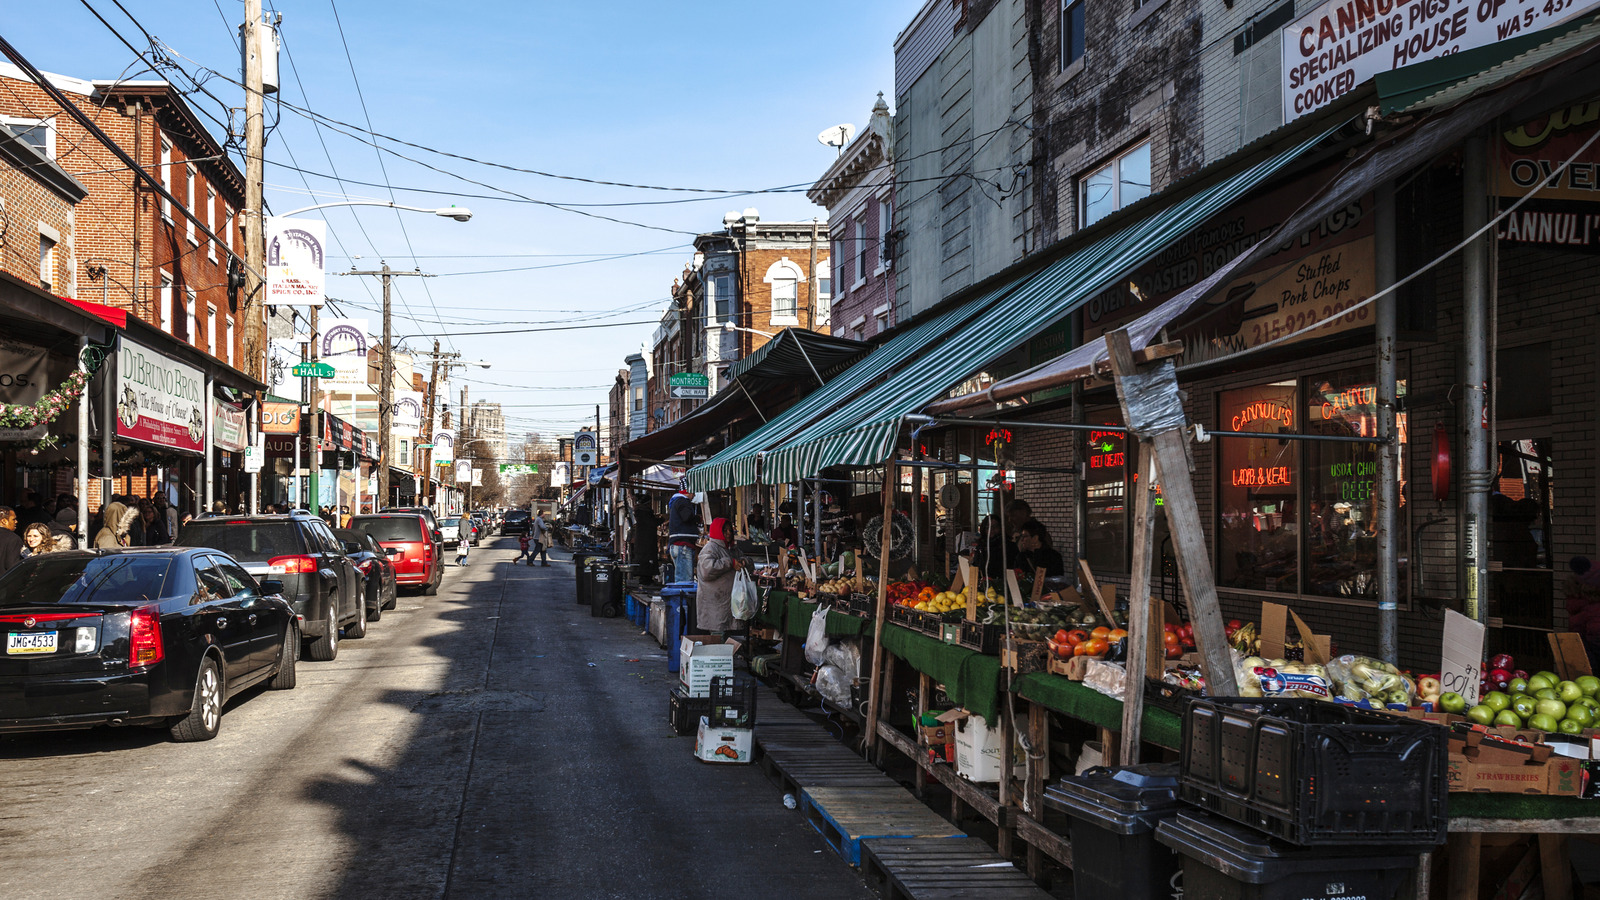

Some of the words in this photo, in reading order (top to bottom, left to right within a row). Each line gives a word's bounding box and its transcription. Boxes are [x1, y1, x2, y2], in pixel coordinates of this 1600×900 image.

[1289, 14, 1403, 89] SPECIALIZING
[1392, 6, 1470, 70] HOUSE
[1294, 68, 1355, 114] COOKED
[1510, 158, 1600, 192] OVE
[1154, 235, 1191, 267] World
[1194, 215, 1245, 251] Famous
[1296, 252, 1342, 283] Stuffed
[1089, 282, 1126, 323] OVEN
[1282, 284, 1308, 308] Pork
[1312, 278, 1351, 300] Chops
[300, 368, 323, 376] HALL
[150, 396, 164, 413] House
[165, 400, 172, 420] of
[1232, 403, 1292, 431] CANNULI'S
[1232, 467, 1255, 485] LAMB
[1266, 466, 1291, 484] VEAL
[1330, 462, 1353, 477] USDA
[1342, 480, 1374, 500] BEEF
[1476, 772, 1539, 781] STRAWBERRIES
